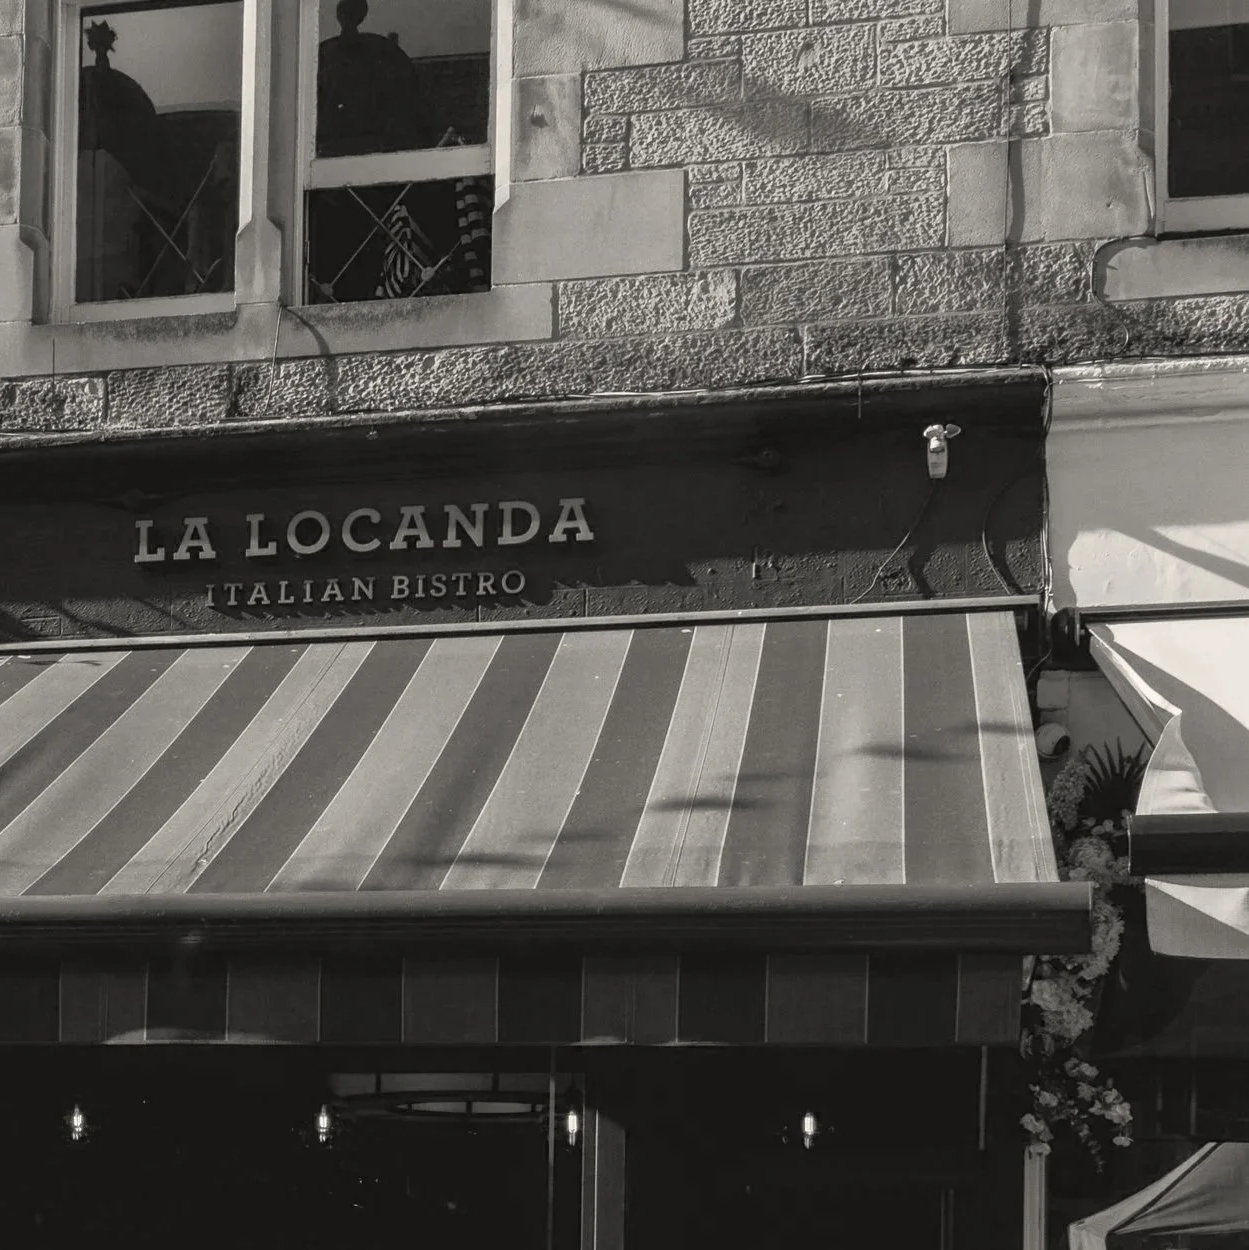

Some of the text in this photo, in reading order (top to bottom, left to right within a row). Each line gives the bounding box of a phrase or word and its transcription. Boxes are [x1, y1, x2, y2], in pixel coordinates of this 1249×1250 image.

[134, 498, 594, 563] LA LOCANDA
[205, 570, 526, 608] ITALIAN BISTRO
